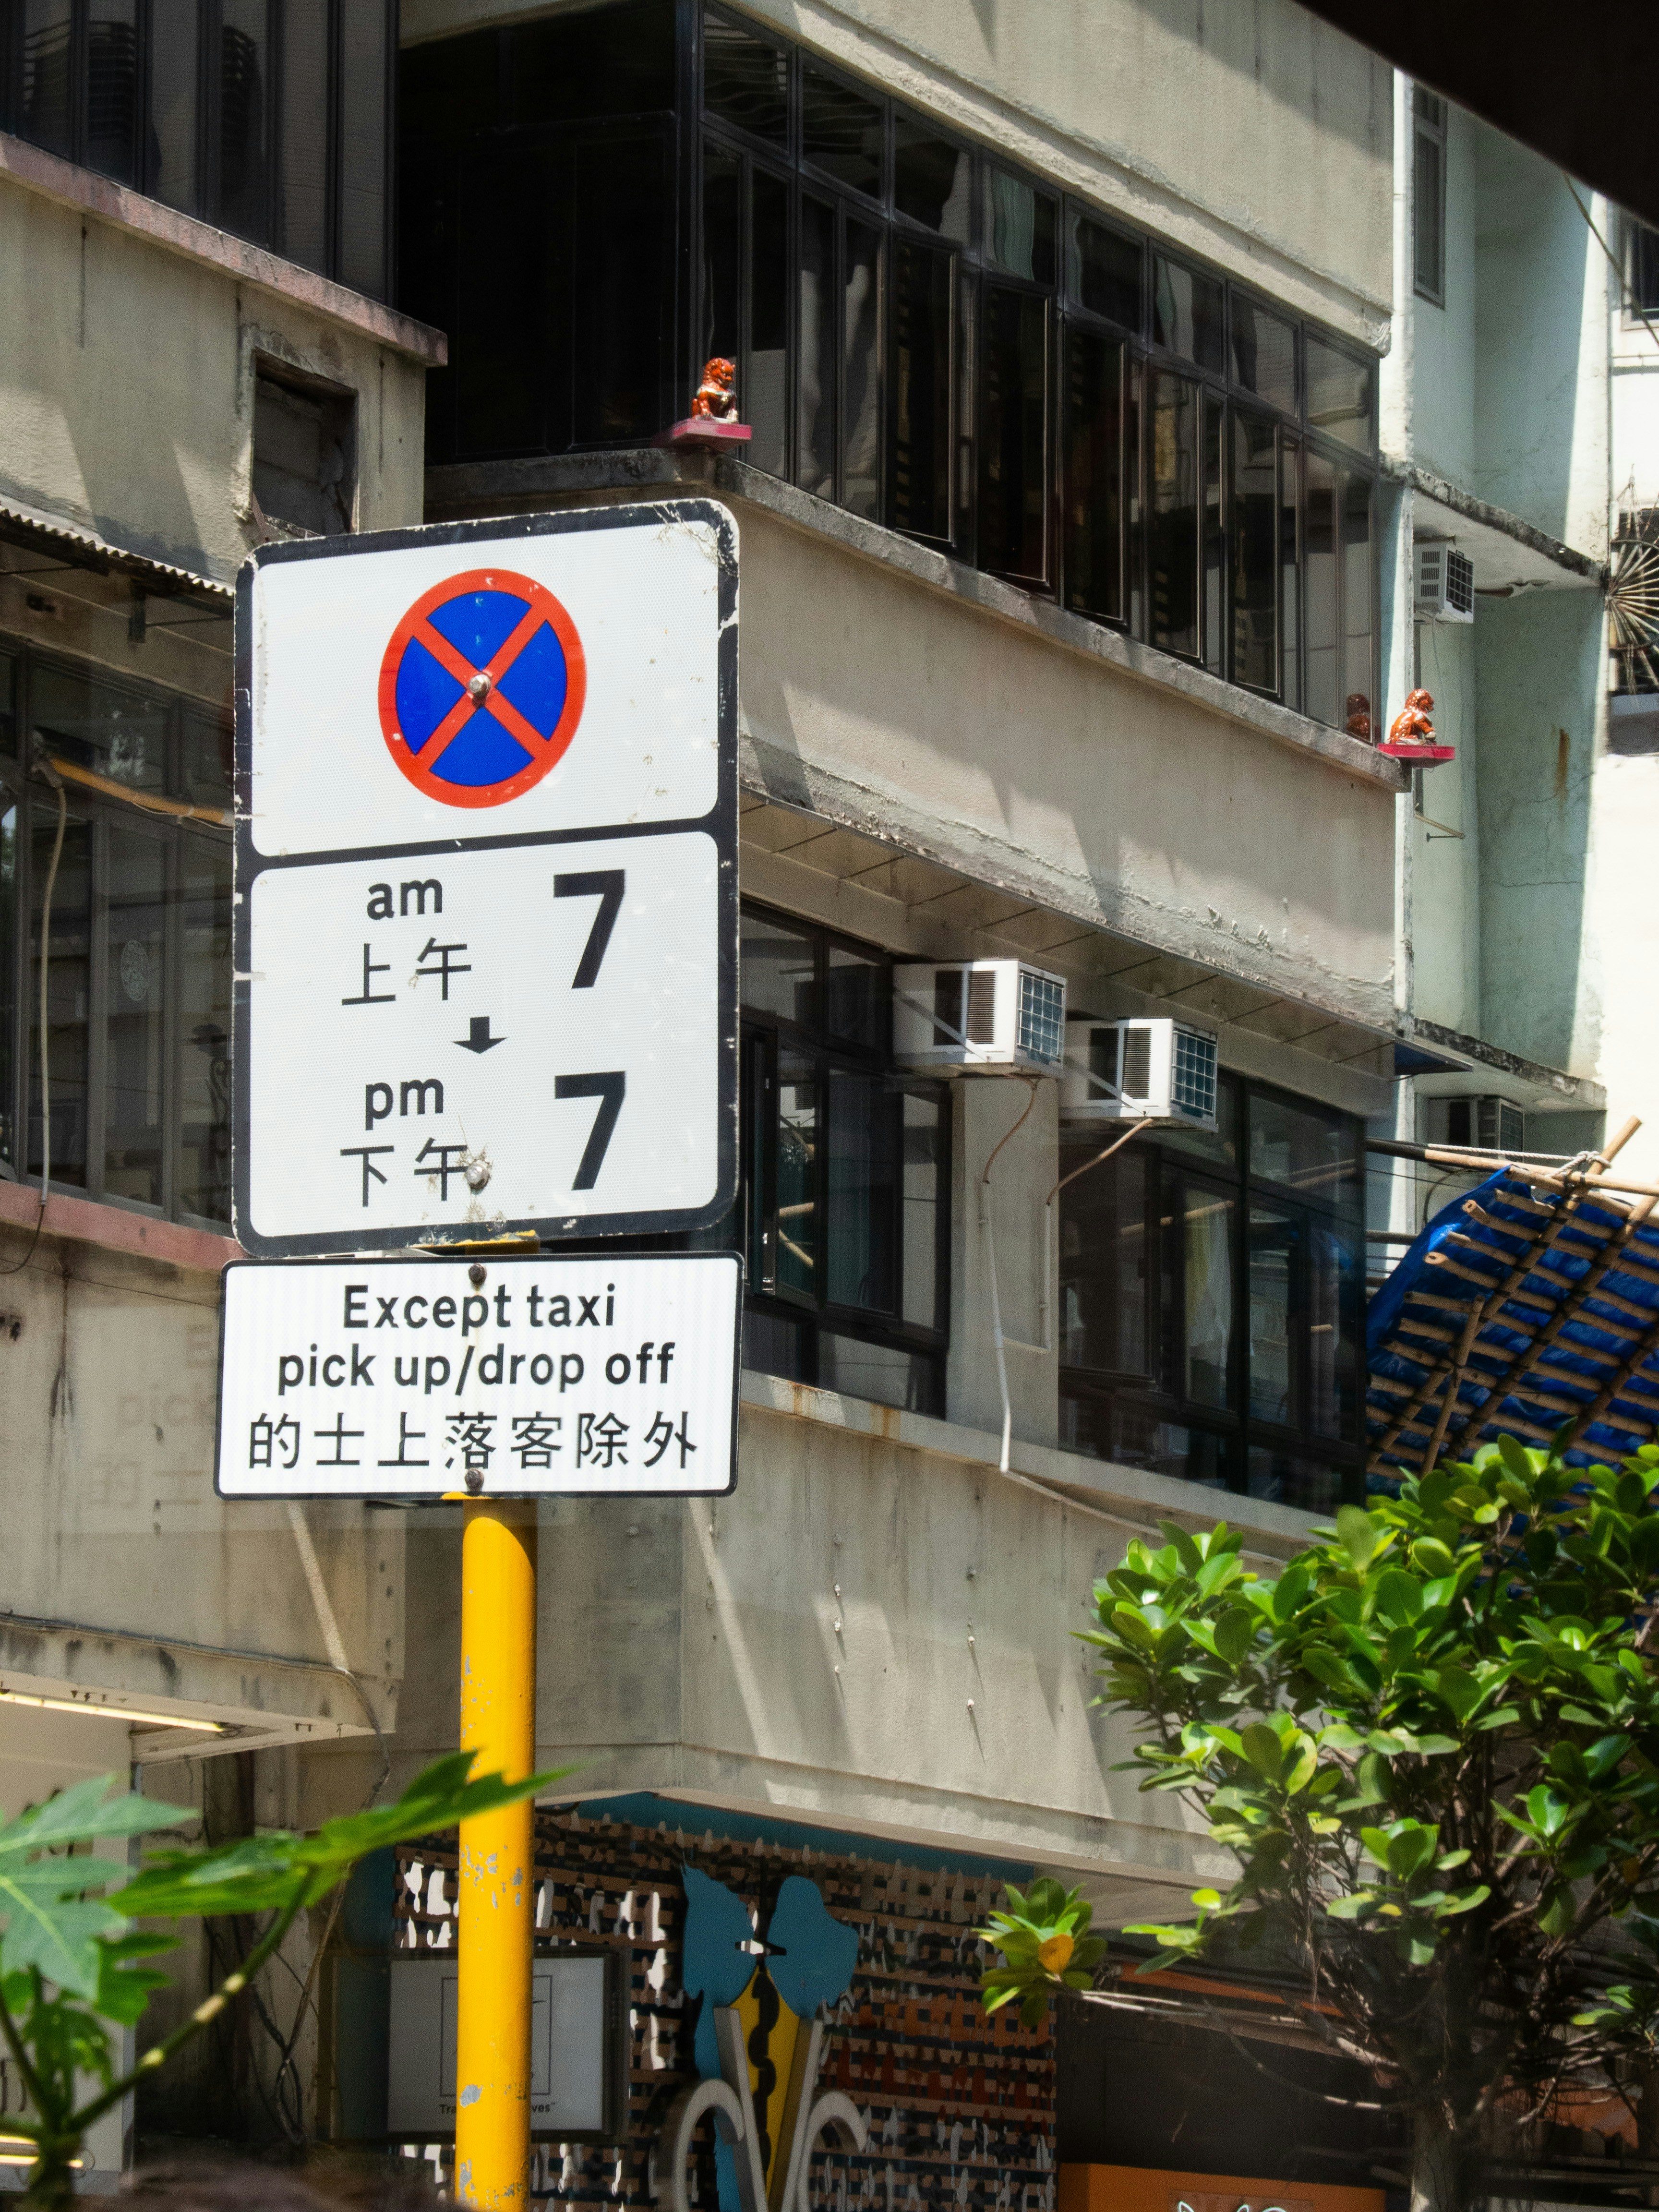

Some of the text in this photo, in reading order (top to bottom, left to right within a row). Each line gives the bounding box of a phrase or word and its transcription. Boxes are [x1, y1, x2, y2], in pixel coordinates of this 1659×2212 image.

[367, 879, 443, 920] am
[553, 869, 625, 989] 7
[342, 938, 471, 1005] 上午
[365, 1078, 444, 1130] pm
[554, 1071, 625, 1190] 7
[341, 1137, 469, 1207] 下午
[344, 1283, 615, 1336] Except taxi
[278, 1342, 675, 1396] pick up/drop off
[249, 1411, 697, 1469] 的士上落客除外
